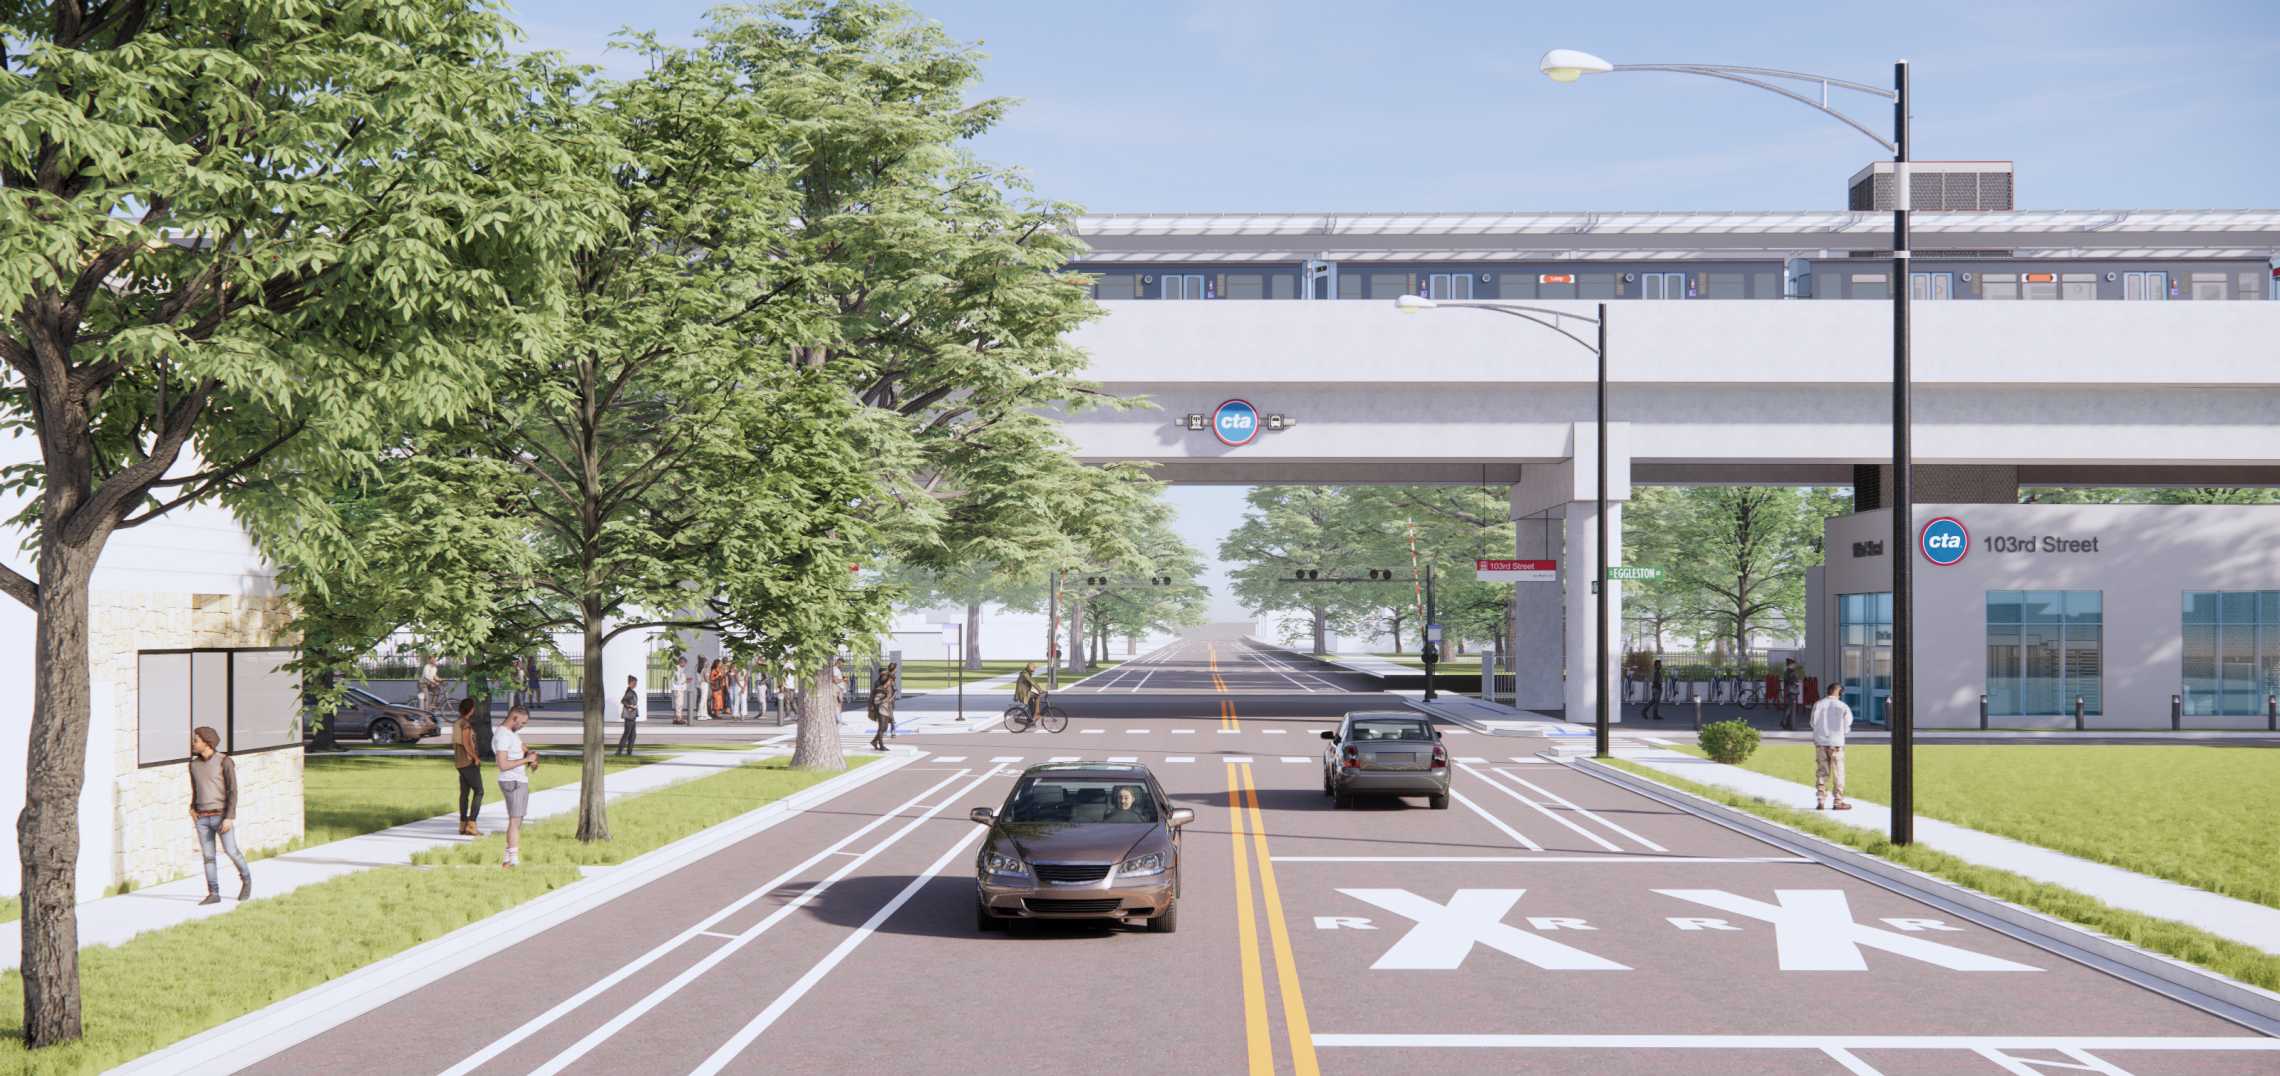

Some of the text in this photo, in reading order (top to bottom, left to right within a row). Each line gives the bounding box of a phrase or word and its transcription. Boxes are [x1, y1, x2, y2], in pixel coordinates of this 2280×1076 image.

[1221, 413, 1252, 429] cta
[1928, 532, 1961, 549] cta
[1983, 536, 2099, 553] 103rd Street
[1490, 561, 1536, 570] 103rd Street
[1613, 567, 1655, 579] EGGLESTON
[1313, 916, 1379, 930] R
[1525, 916, 1599, 930] R
[1665, 917, 1745, 931] R
[1879, 918, 1967, 931] R
